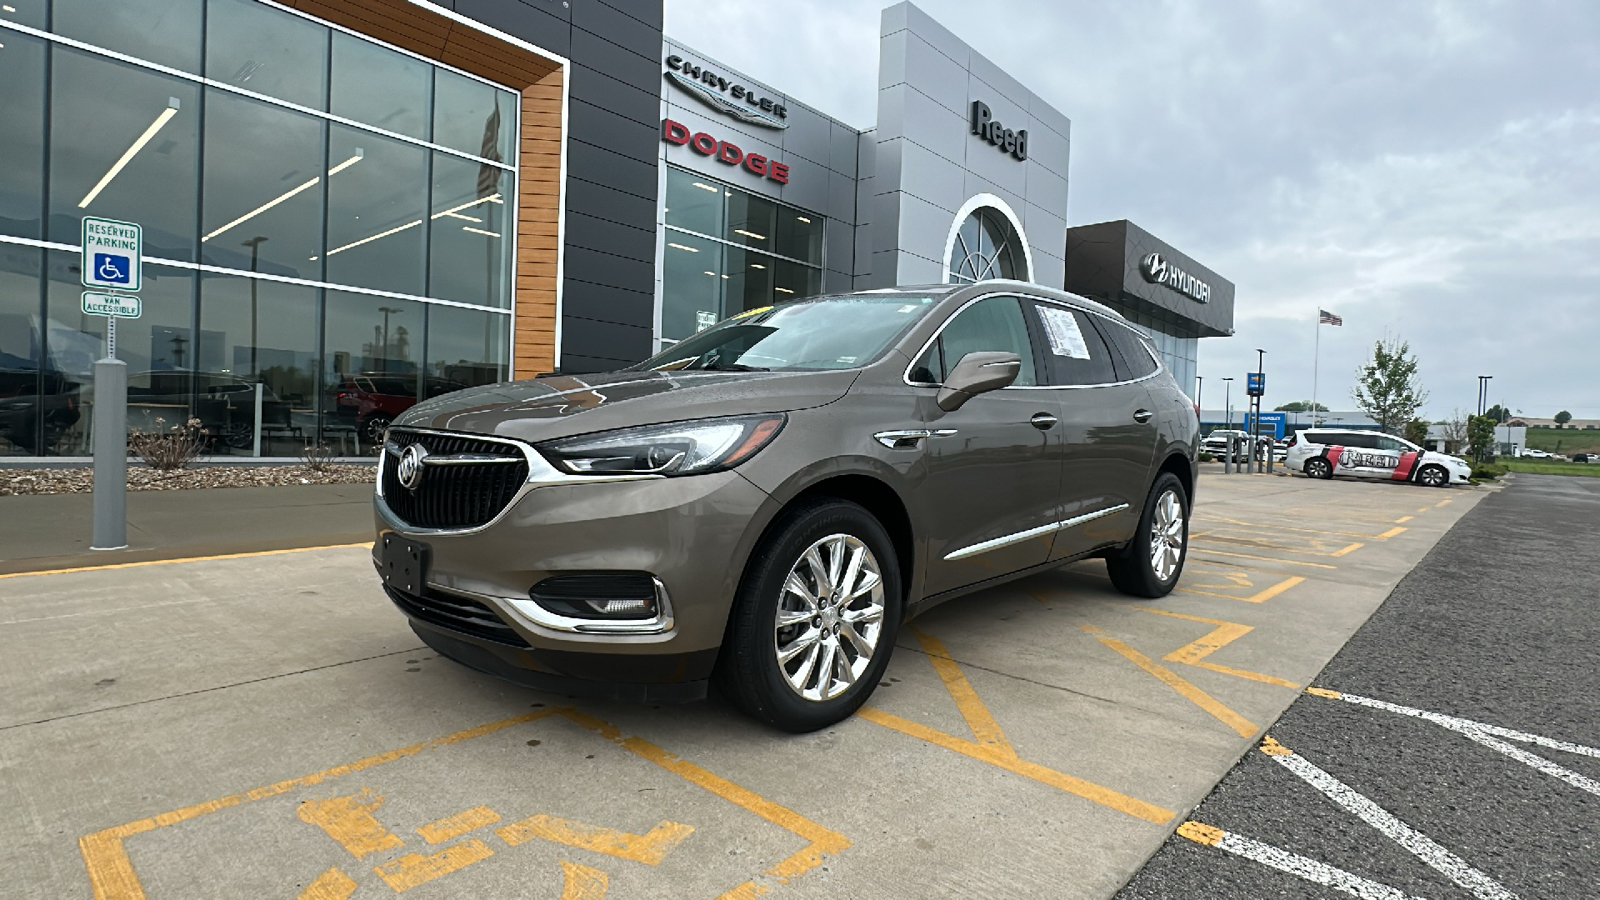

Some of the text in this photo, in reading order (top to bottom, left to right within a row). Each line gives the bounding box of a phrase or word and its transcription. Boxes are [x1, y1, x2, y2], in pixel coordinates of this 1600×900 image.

[666, 55, 788, 119] CHRYSLER
[972, 100, 1028, 162] Reed
[661, 118, 790, 184] DODGE
[88, 224, 136, 239] RESERVED
[88, 236, 136, 251] PARKING
[1169, 265, 1211, 304] HYUNDAI
[87, 303, 137, 314] ACCESSIBLE
[104, 297, 120, 305] VAN
